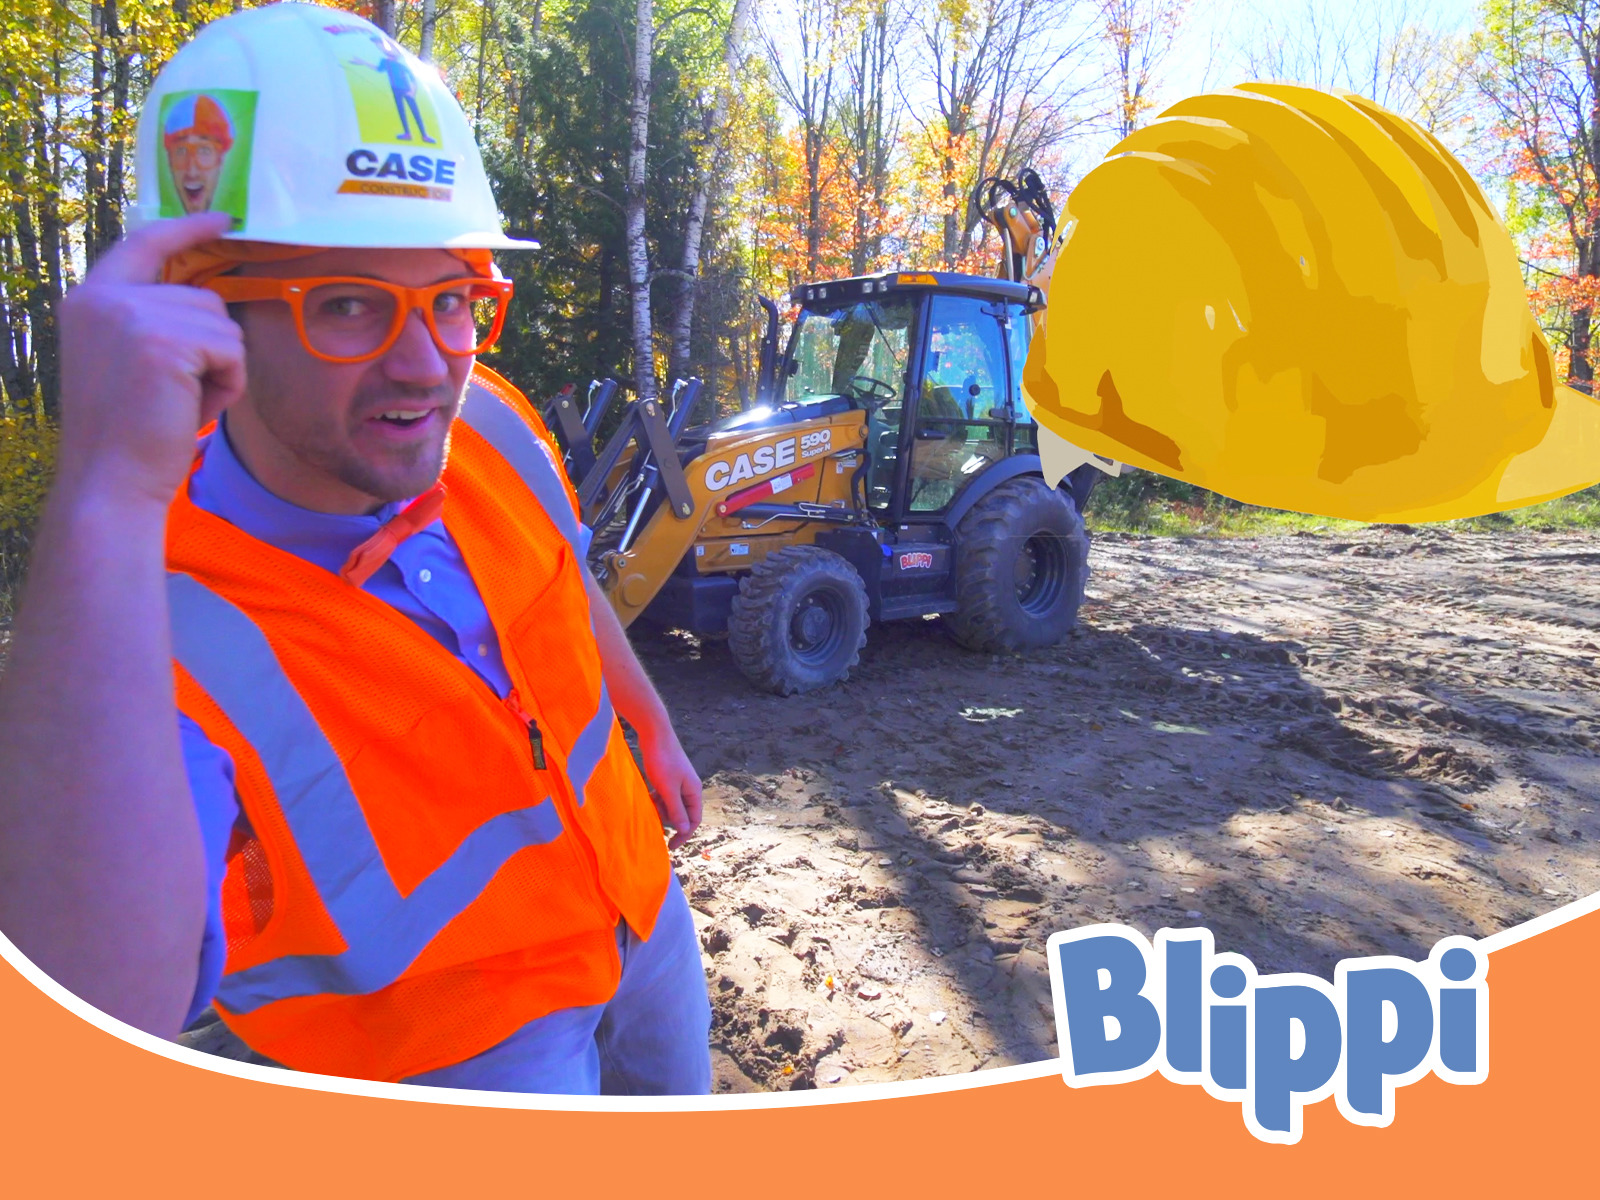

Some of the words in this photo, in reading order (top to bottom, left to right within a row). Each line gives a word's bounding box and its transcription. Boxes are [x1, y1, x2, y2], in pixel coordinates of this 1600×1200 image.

[346, 149, 456, 185] CASE
[800, 429, 831, 450] 590
[802, 446, 824, 458] Super
[824, 442, 831, 451] N
[704, 437, 796, 491] CASE
